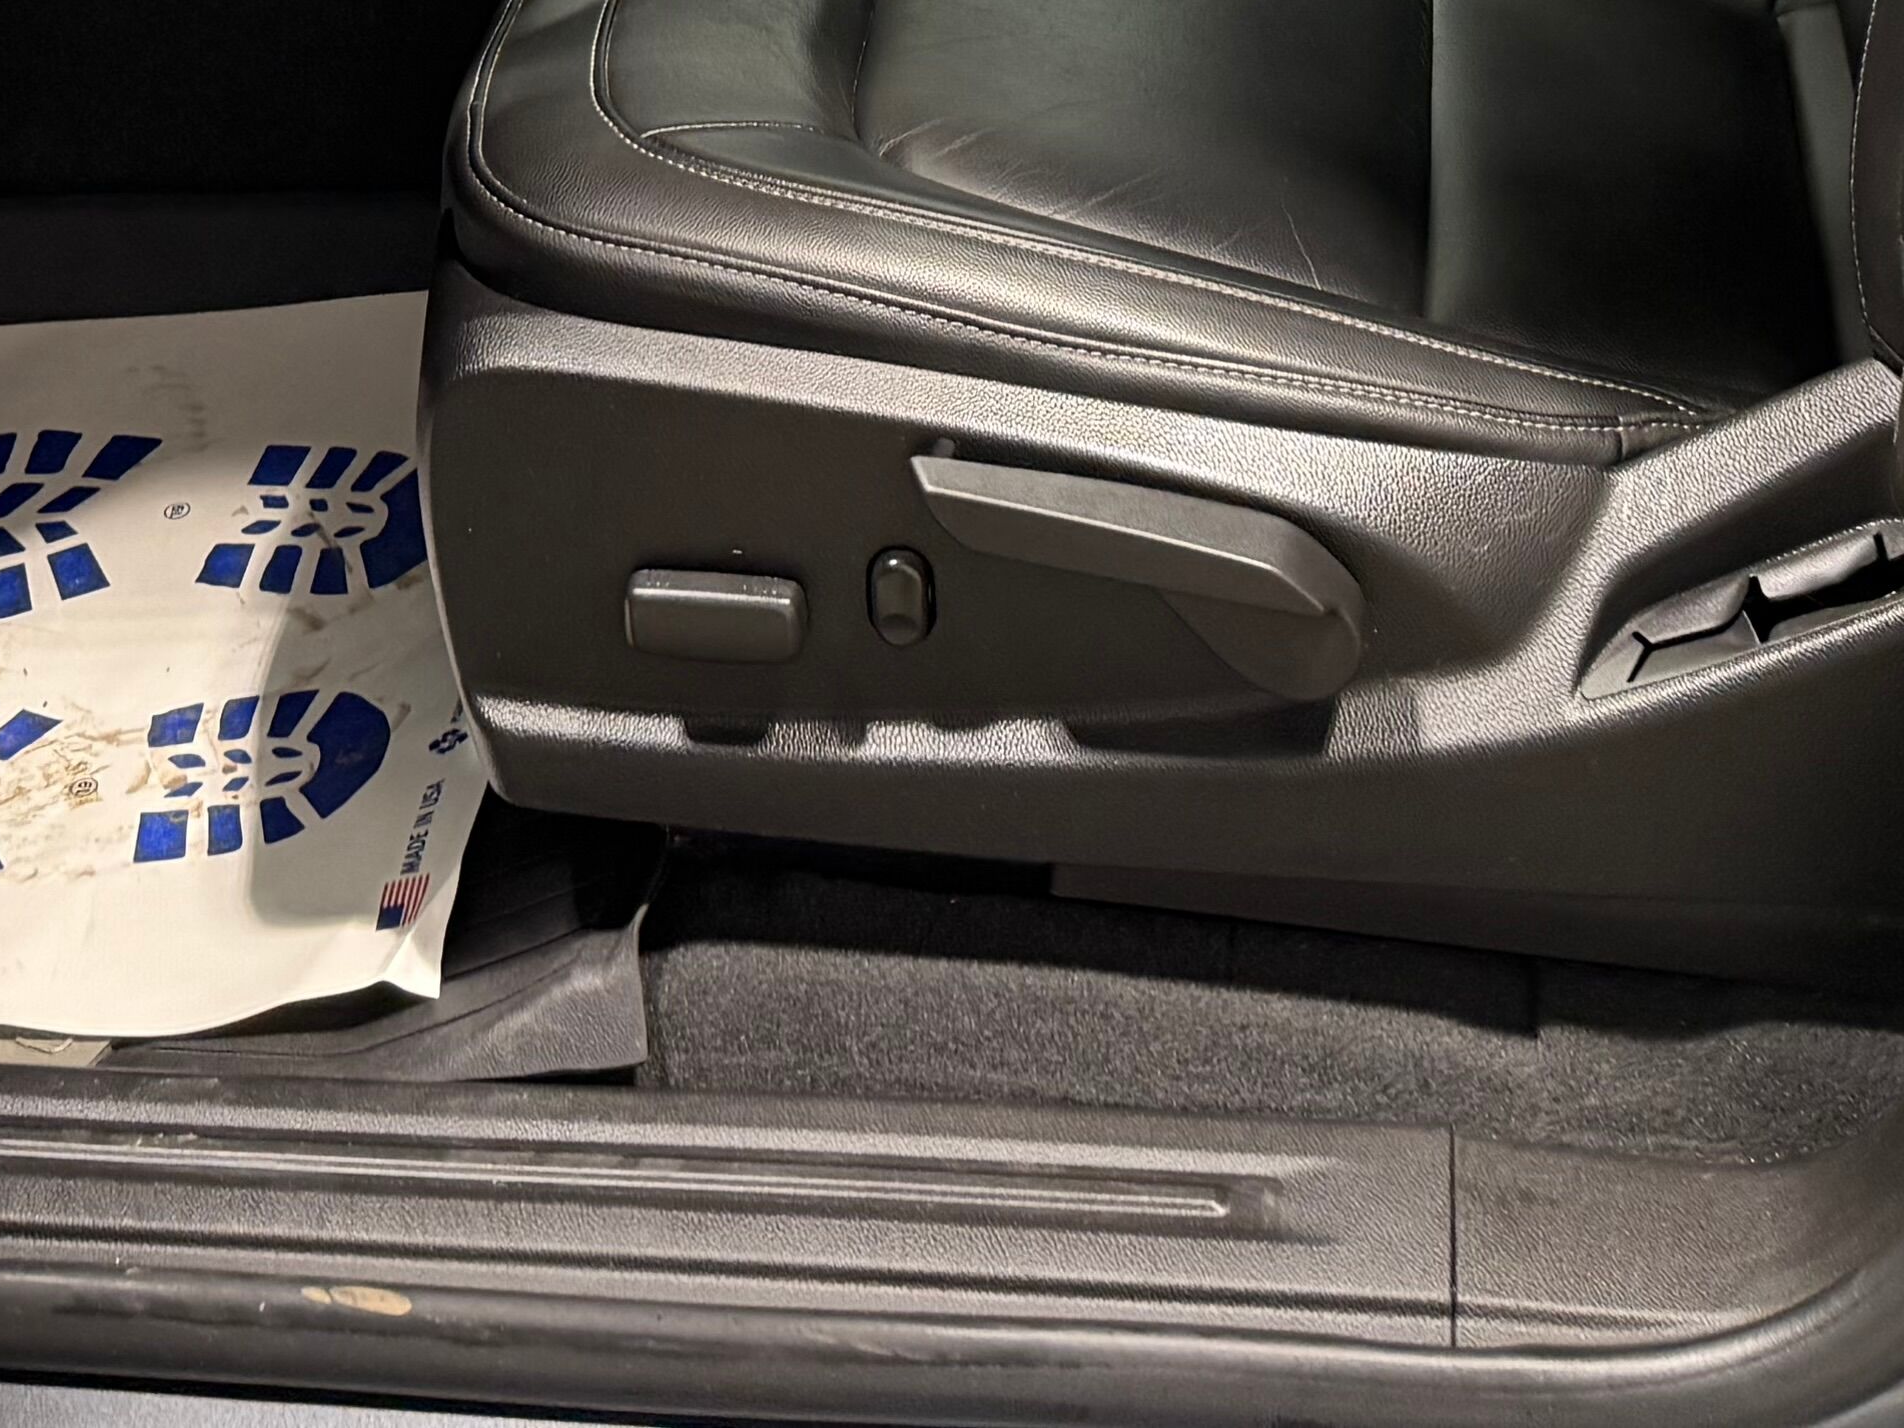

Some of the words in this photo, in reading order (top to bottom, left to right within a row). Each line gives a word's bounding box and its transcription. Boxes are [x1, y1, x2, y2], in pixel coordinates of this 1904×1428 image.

[419, 778, 446, 811] USA
[413, 810, 434, 831] IN
[400, 829, 429, 876] MADE
